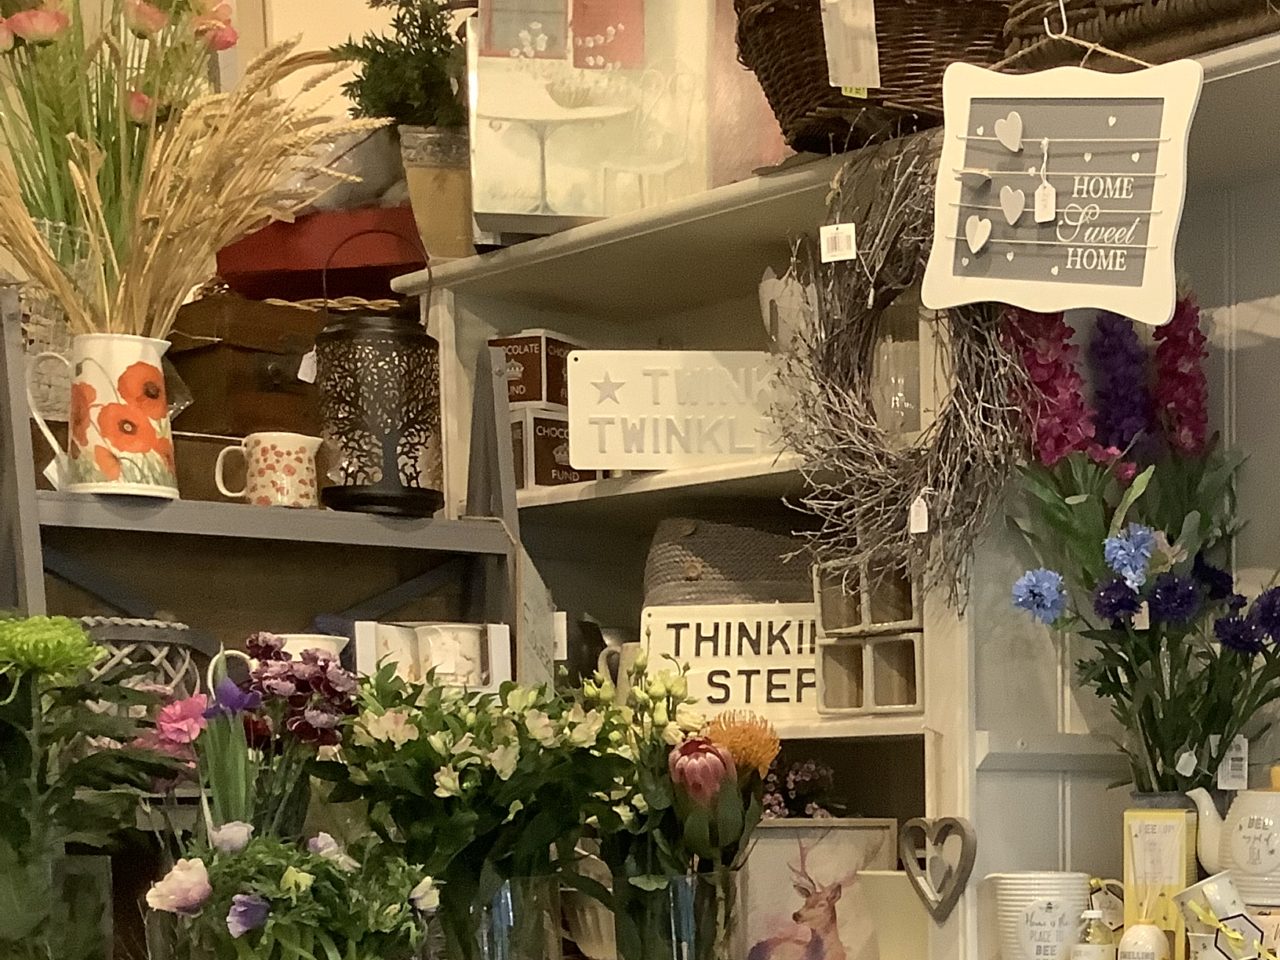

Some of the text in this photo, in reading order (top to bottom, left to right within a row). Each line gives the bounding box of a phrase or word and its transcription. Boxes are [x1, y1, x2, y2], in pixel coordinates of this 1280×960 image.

[1072, 176, 1134, 199] HOME
[1056, 204, 1141, 243] Sweet
[1066, 248, 1127, 271] HOME
[552, 470, 580, 482] FUND
[666, 619, 816, 657] THINKI
[1036, 945, 1056, 956] BEE
